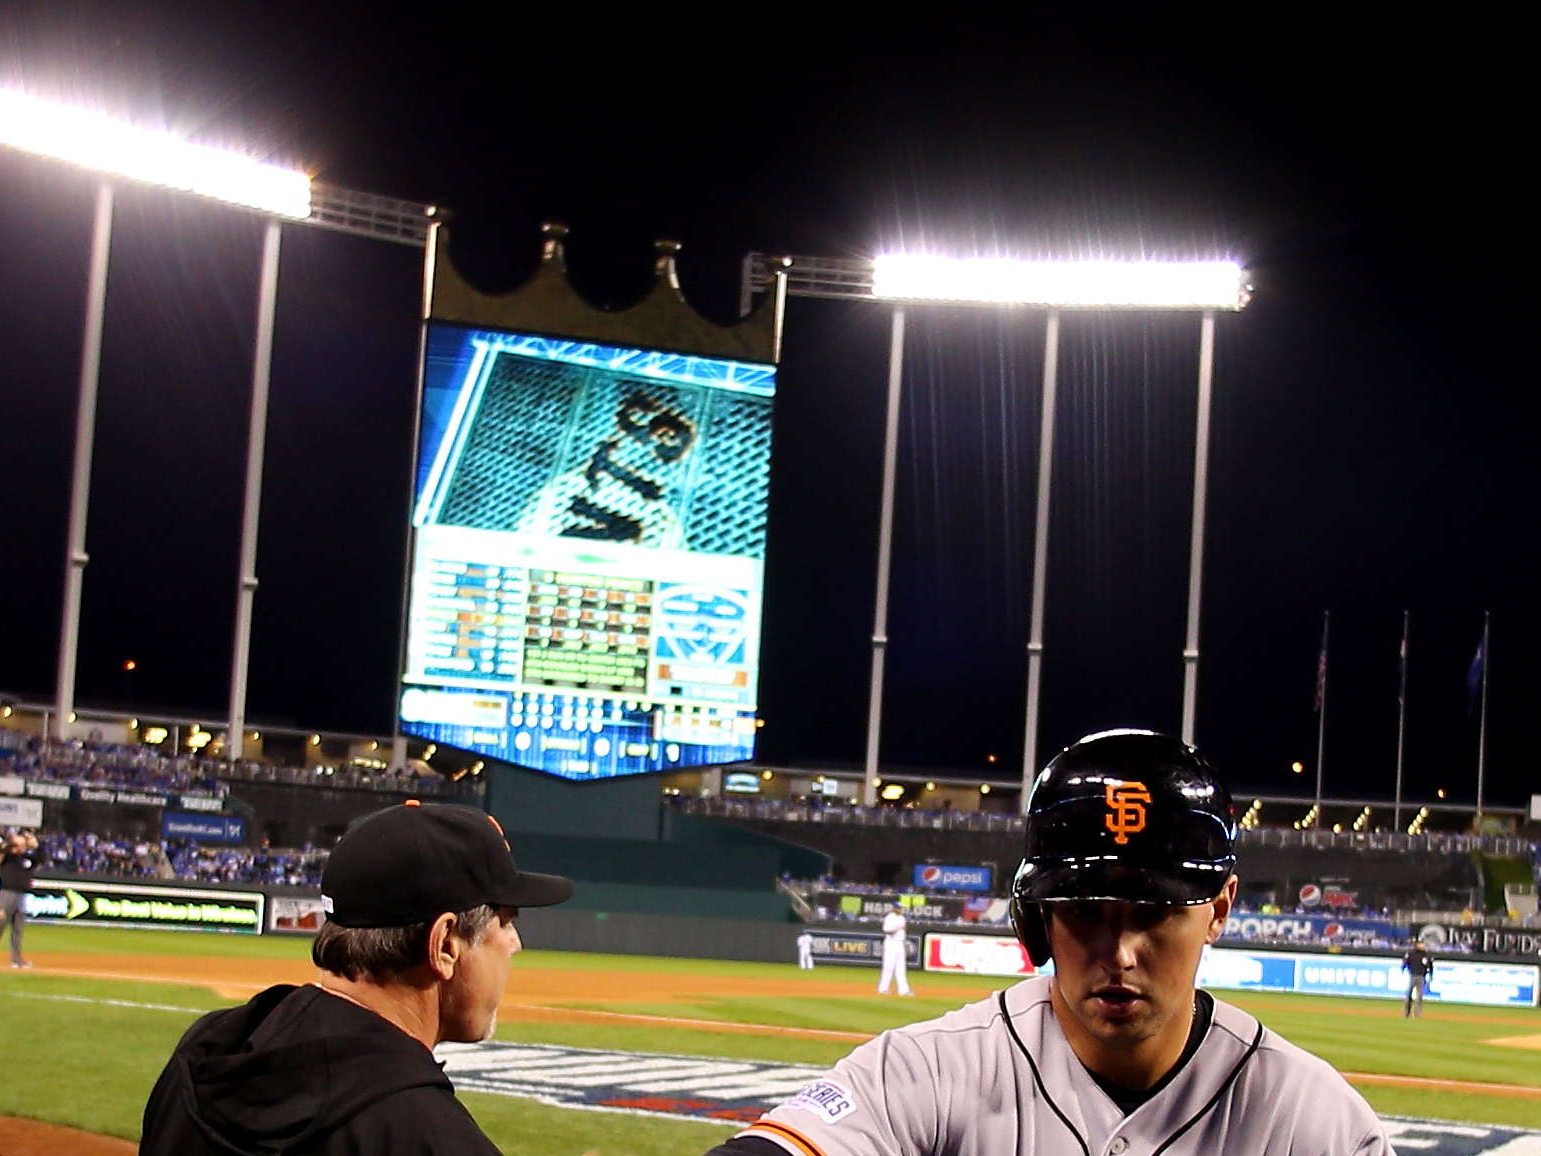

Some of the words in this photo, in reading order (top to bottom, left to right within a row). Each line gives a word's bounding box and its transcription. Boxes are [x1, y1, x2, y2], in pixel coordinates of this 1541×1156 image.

[943, 871, 982, 885] pepsi
[1225, 916, 1312, 938] PORCH
[833, 941, 868, 953] LIVE
[1304, 965, 1386, 987] UNITED
